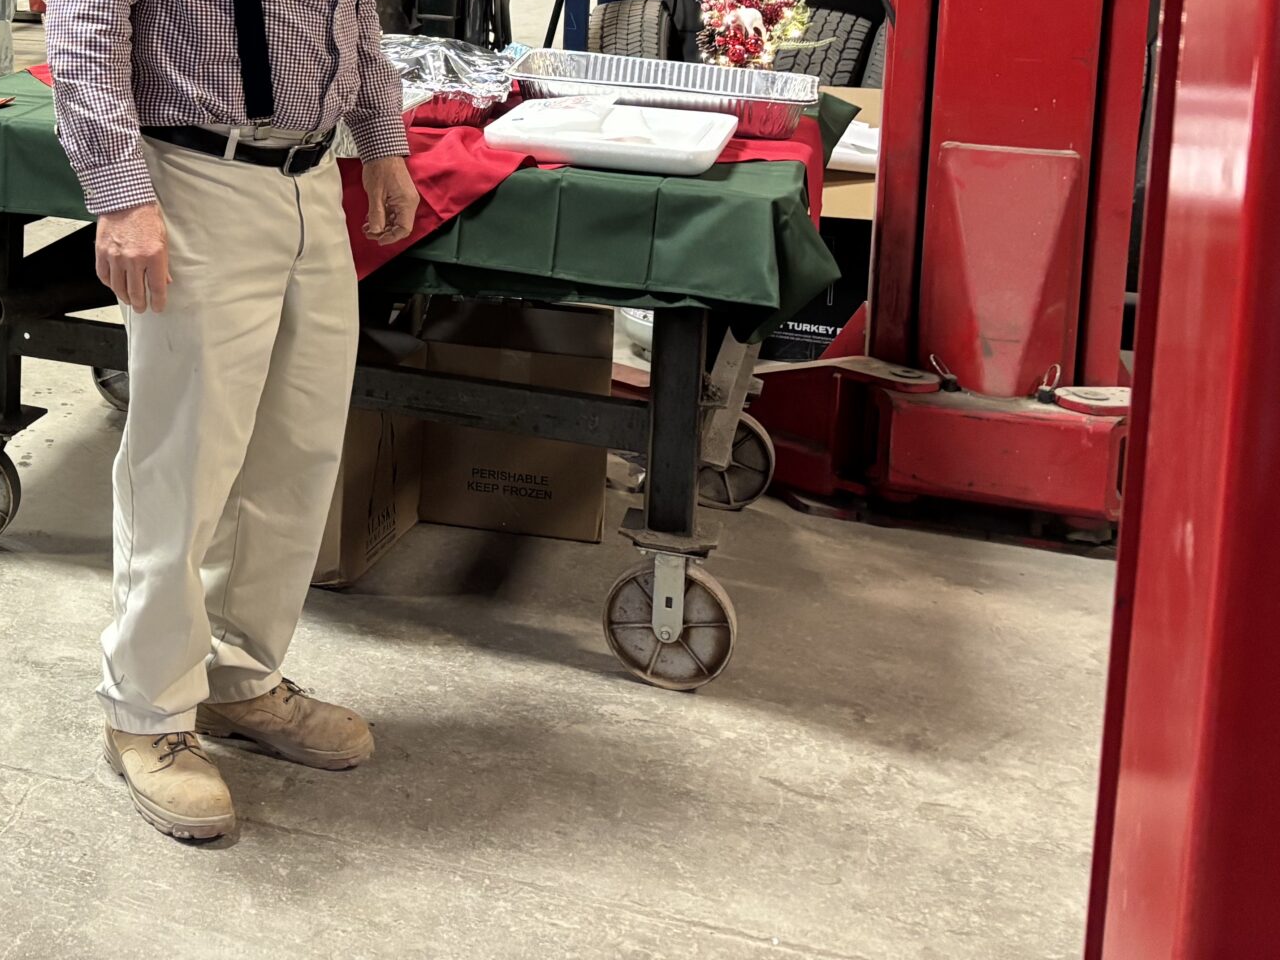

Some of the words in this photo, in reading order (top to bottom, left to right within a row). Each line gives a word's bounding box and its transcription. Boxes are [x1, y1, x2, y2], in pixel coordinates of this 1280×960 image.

[786, 321, 835, 335] TURKEY
[471, 467, 549, 486] PERISHABLE
[467, 480, 499, 493] KEEP
[502, 485, 553, 500] FROZEN
